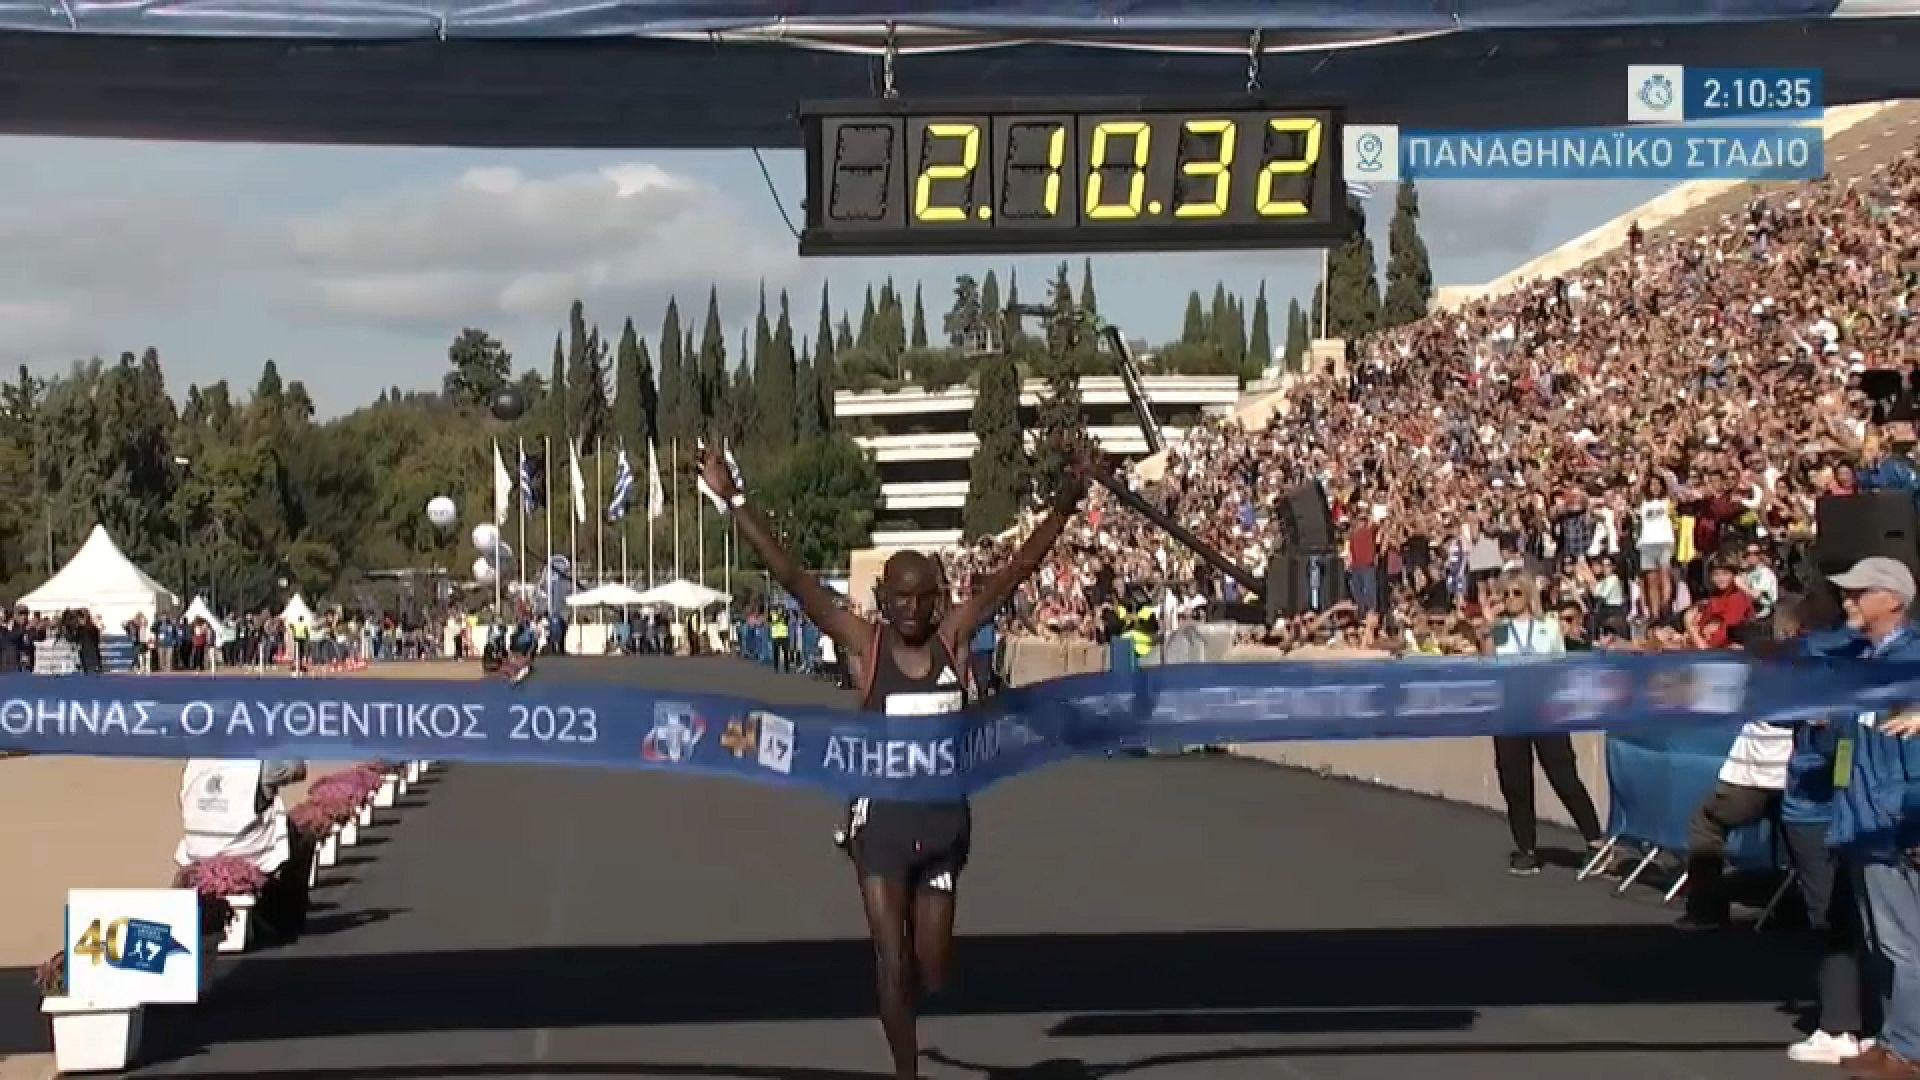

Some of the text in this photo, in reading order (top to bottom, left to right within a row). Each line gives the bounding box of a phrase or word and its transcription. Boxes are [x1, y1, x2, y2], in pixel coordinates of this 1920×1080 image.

[226, 701, 488, 738] ΑΥΘΕΝΤΙΚΟΣ
[508, 705, 599, 742] 2023
[823, 735, 957, 779] ATHENS
